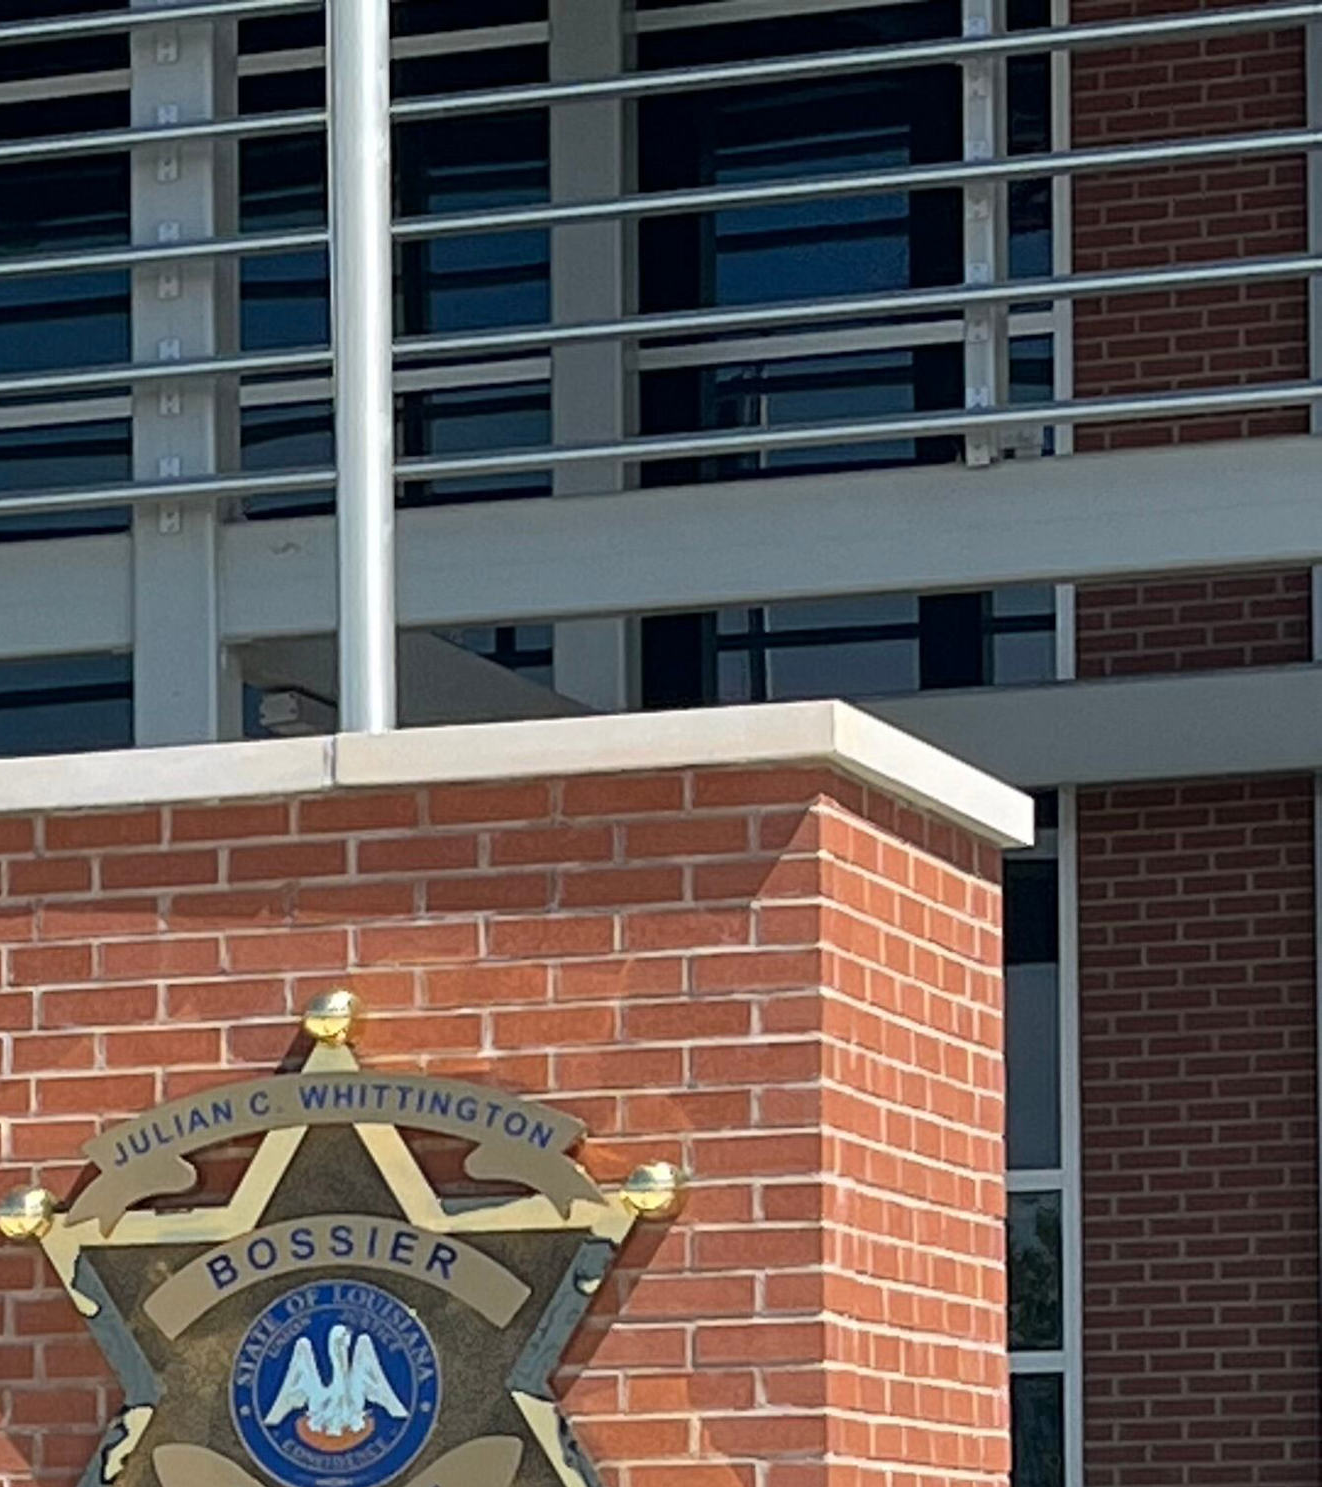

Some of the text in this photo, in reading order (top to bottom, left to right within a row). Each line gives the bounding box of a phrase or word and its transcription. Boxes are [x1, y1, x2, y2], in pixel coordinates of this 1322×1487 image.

[113, 1099, 234, 1167] JULIAN
[299, 1084, 556, 1149] WHITTINGTON
[207, 1226, 459, 1290] BOSSIER
[236, 1284, 435, 1387] STATE OF LOUISIANA
